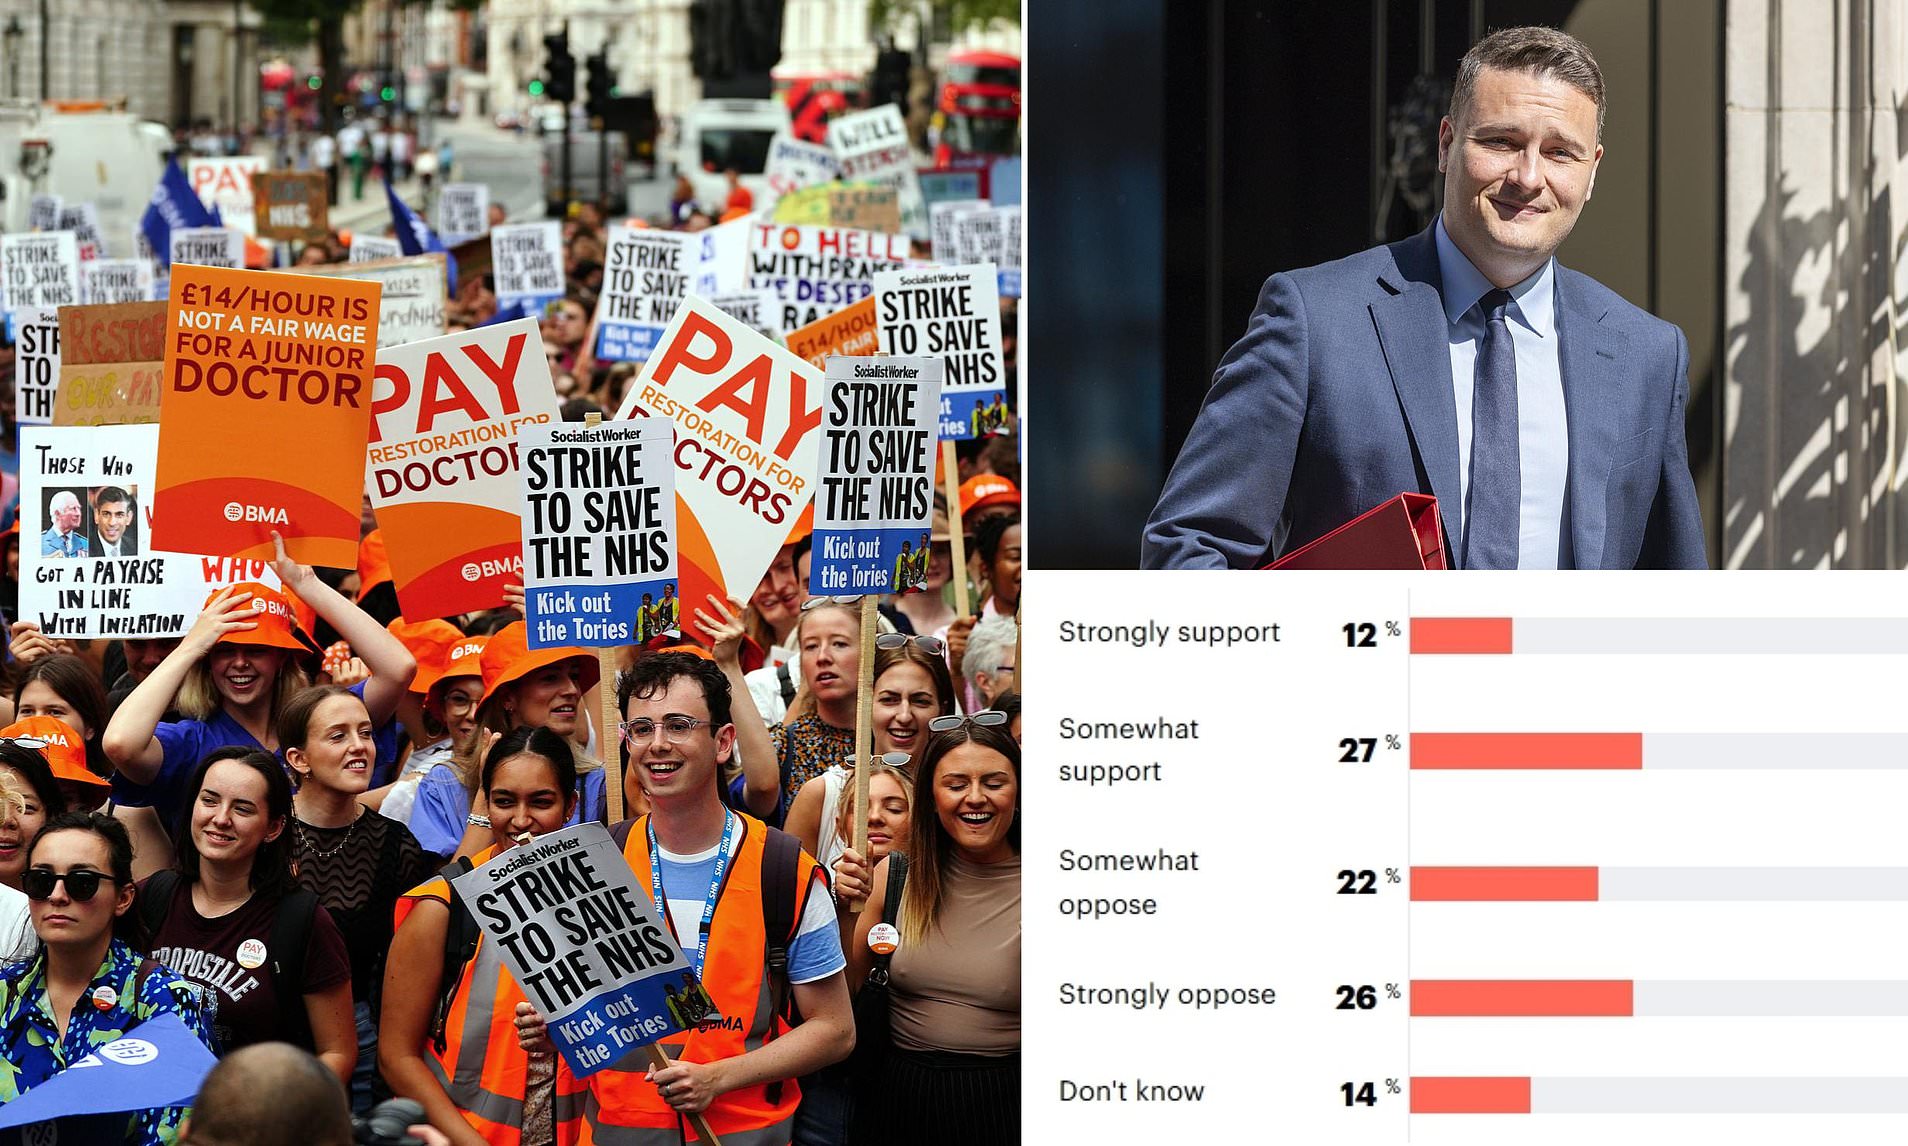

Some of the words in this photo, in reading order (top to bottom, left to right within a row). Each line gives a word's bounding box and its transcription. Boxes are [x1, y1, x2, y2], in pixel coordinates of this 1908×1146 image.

[194, 163, 259, 195] PAY
[5, 244, 59, 265] STRIKE
[612, 242, 682, 272] STRIKE
[758, 225, 800, 250] TO
[819, 231, 904, 262] HELL
[7, 266, 27, 286] TO
[32, 263, 69, 284] SAVE
[90, 271, 138, 288] STRIKE
[753, 253, 823, 276] WITH
[8, 287, 35, 307] THE
[42, 285, 73, 305] NHS
[611, 268, 634, 293] TO
[642, 272, 689, 299] SAVE
[181, 282, 334, 319] £14/HOUR
[343, 297, 369, 321] IS
[608, 294, 642, 320] THE
[650, 298, 680, 323] NH
[883, 286, 974, 322] STRIKE
[178, 309, 225, 331] NOT
[228, 315, 245, 333] A
[250, 316, 299, 338] FAIR
[304, 321, 366, 344] WAGE
[783, 305, 834, 330] RA
[797, 309, 877, 359] £14/HOU
[883, 324, 917, 356] TO
[928, 318, 991, 353] SAVE
[176, 332, 233, 358] FOR
[237, 338, 257, 360] A
[262, 340, 365, 370] JUNIOR
[21, 356, 51, 386] TO
[174, 358, 362, 409] DOCTOR
[945, 352, 997, 386] NHS
[67, 370, 117, 411] OUR
[368, 333, 527, 443] PAY
[651, 310, 823, 462] PAY
[21, 388, 56, 417] TH
[829, 381, 918, 427] STRIKE
[369, 422, 507, 464] RESTORATION
[640, 385, 767, 471] RESTORATION
[765, 462, 806, 495] FOR
[826, 429, 861, 474] TO
[867, 429, 929, 474] SAVE
[35, 445, 86, 475] THOSE
[102, 455, 133, 477] WHO
[527, 443, 644, 491] STRIKE
[527, 491, 571, 535] TO
[583, 486, 662, 534] SAVE
[823, 477, 872, 521] THE
[879, 476, 929, 520] NHS
[245, 505, 289, 525] BMA
[529, 536, 593, 579] THE
[605, 530, 669, 577] NHS
[823, 535, 855, 559] Kick
[858, 536, 880, 559] out
[36, 566, 64, 583] GOT
[74, 566, 85, 583] A
[93, 558, 164, 585] PAYRISE
[201, 556, 265, 583] WHO
[481, 555, 525, 577] BMA
[821, 564, 848, 588] the
[851, 564, 888, 588] Tories
[58, 589, 84, 609] IN
[91, 588, 131, 610] LINE
[268, 600, 290, 620] BMA
[537, 590, 575, 615] Kick
[582, 591, 611, 613] out
[39, 612, 87, 635] WITH
[99, 613, 185, 636] INFLATION
[537, 619, 567, 642] the
[572, 617, 628, 640] Tories
[726, 815, 734, 832] NHS
[650, 849, 658, 866] NHS
[721, 836, 730, 854] NHS
[715, 858, 725, 877] NHS
[476, 851, 607, 934] STRIKE
[655, 895, 663, 913] NHS
[708, 881, 719, 900] NHS
[497, 923, 556, 974] TO
[554, 886, 648, 946] SAVE
[243, 942, 264, 955] PAY
[697, 942, 706, 960] NHS
[522, 950, 602, 1014] THE
[595, 925, 675, 980] NHS
[559, 1009, 605, 1045] Kick
[605, 993, 639, 1019] out
[709, 1017, 744, 1032] BMA
[576, 1043, 611, 1069] the
[606, 1014, 668, 1049] Tories
